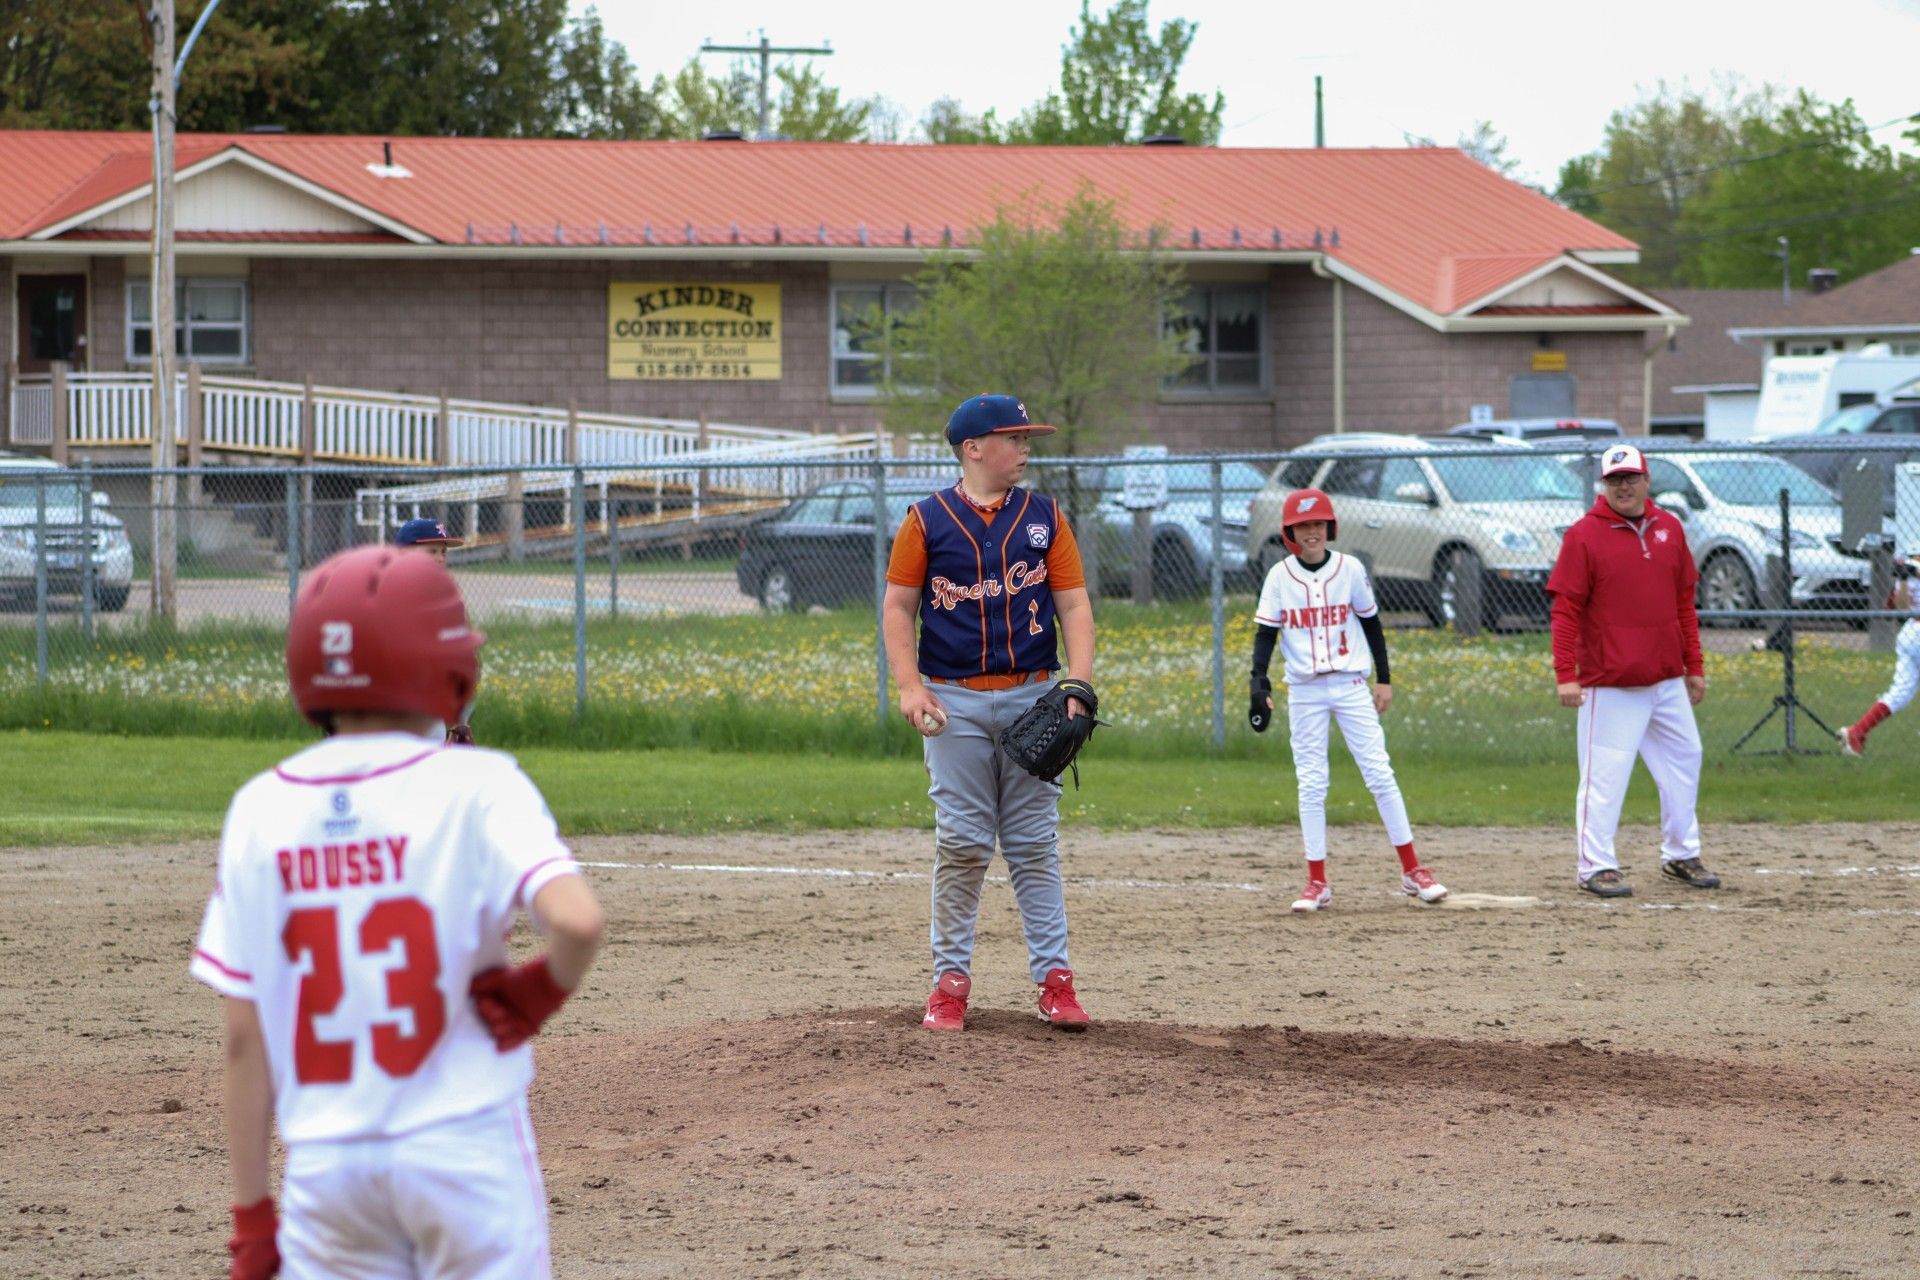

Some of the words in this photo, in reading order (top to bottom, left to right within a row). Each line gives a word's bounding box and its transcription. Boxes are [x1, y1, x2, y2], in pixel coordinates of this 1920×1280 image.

[634, 286, 754, 317] KINDER
[616, 319, 773, 337] CONNECTION
[641, 343, 698, 361] Nursery
[703, 343, 749, 357] School
[931, 576, 1003, 611] River
[1028, 599, 1043, 636] 1
[276, 836, 409, 893] ROUSSY
[281, 896, 447, 1085] 23
